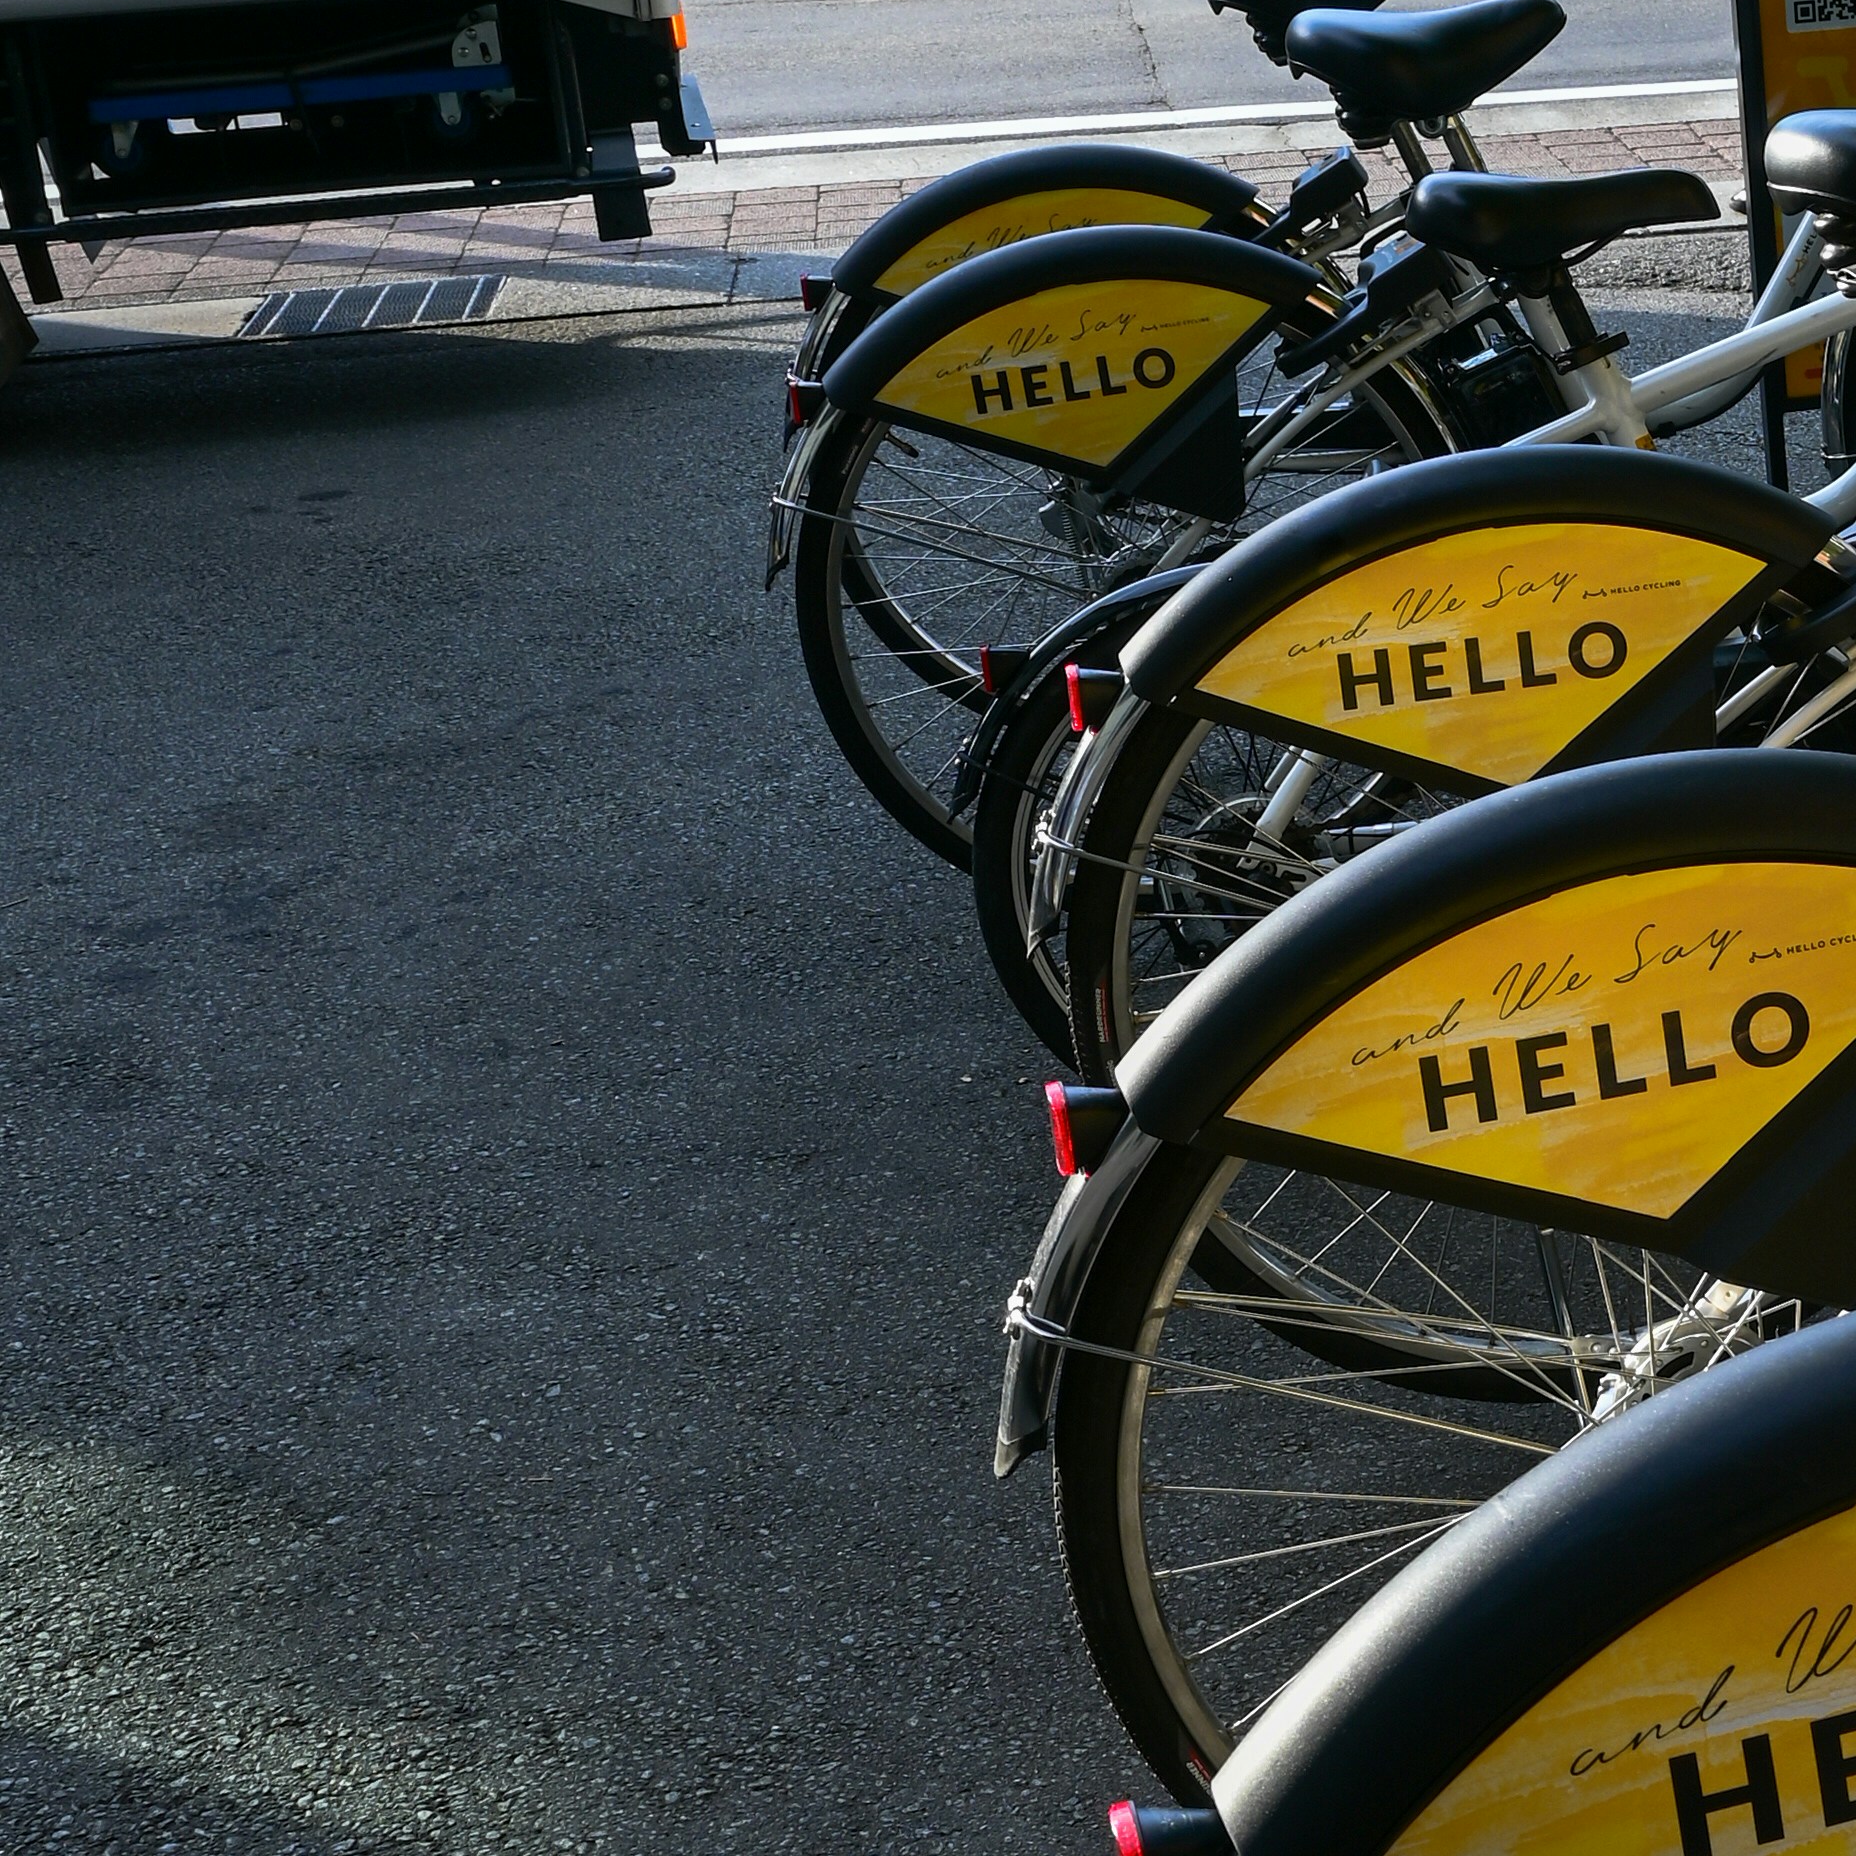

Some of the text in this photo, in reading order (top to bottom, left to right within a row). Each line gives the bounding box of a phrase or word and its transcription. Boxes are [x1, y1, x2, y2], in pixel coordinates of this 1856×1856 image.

[926, 241, 975, 270] and
[936, 309, 1137, 379] and We Say
[970, 347, 1177, 415] HELLO
[1287, 565, 1580, 659] and We Say
[1610, 579, 1681, 597] HELLO CYCLING
[1336, 621, 1629, 712] HELLO
[1785, 940, 1826, 958] HELLO
[1350, 923, 1744, 1068] and We Say
[1418, 991, 1812, 1134] HELLO
[1568, 1664, 1738, 1780] and
